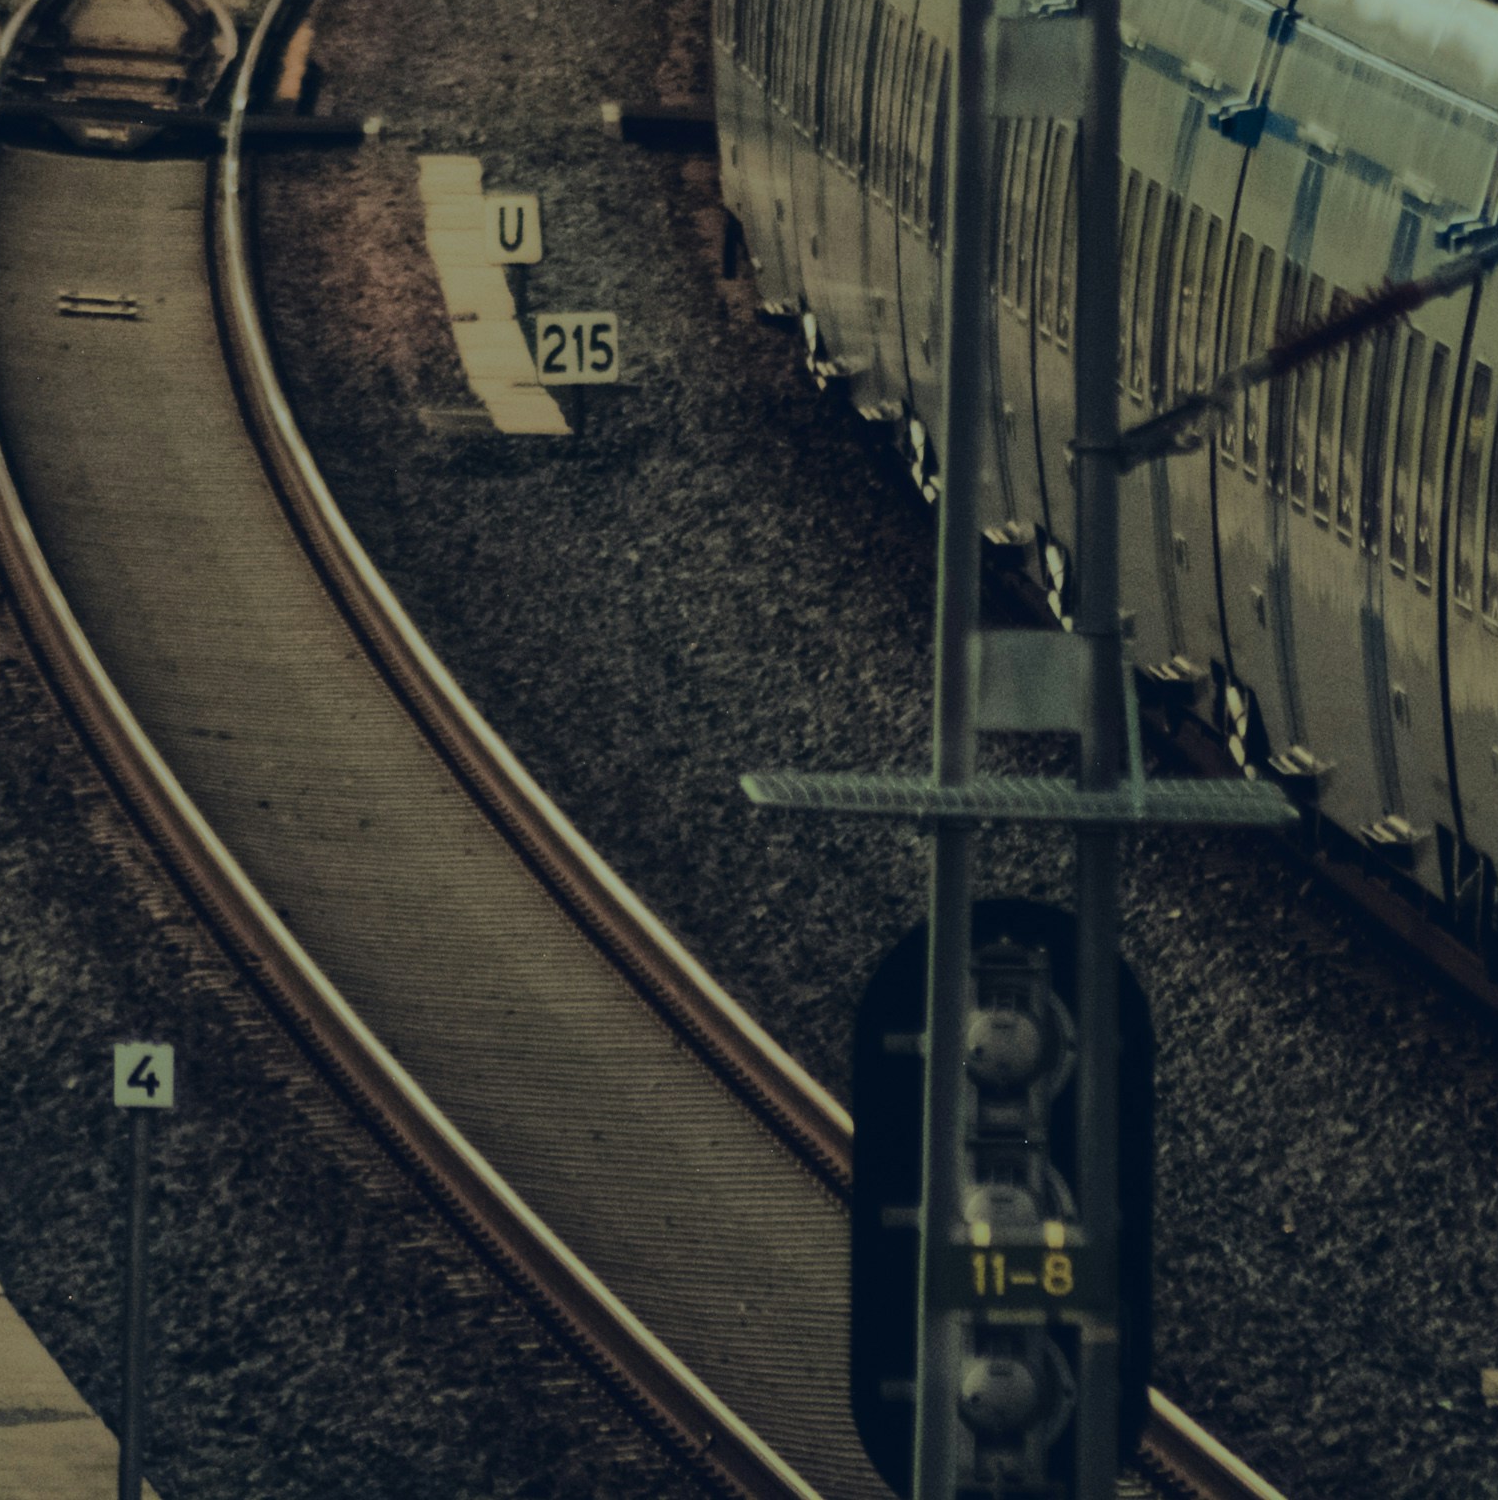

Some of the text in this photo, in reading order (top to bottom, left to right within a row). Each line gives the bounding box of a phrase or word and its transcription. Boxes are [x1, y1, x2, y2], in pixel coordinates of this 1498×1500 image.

[499, 206, 524, 252] U
[543, 323, 615, 373] 215
[127, 1054, 160, 1098] 4
[973, 1252, 1074, 1297] 11-8
